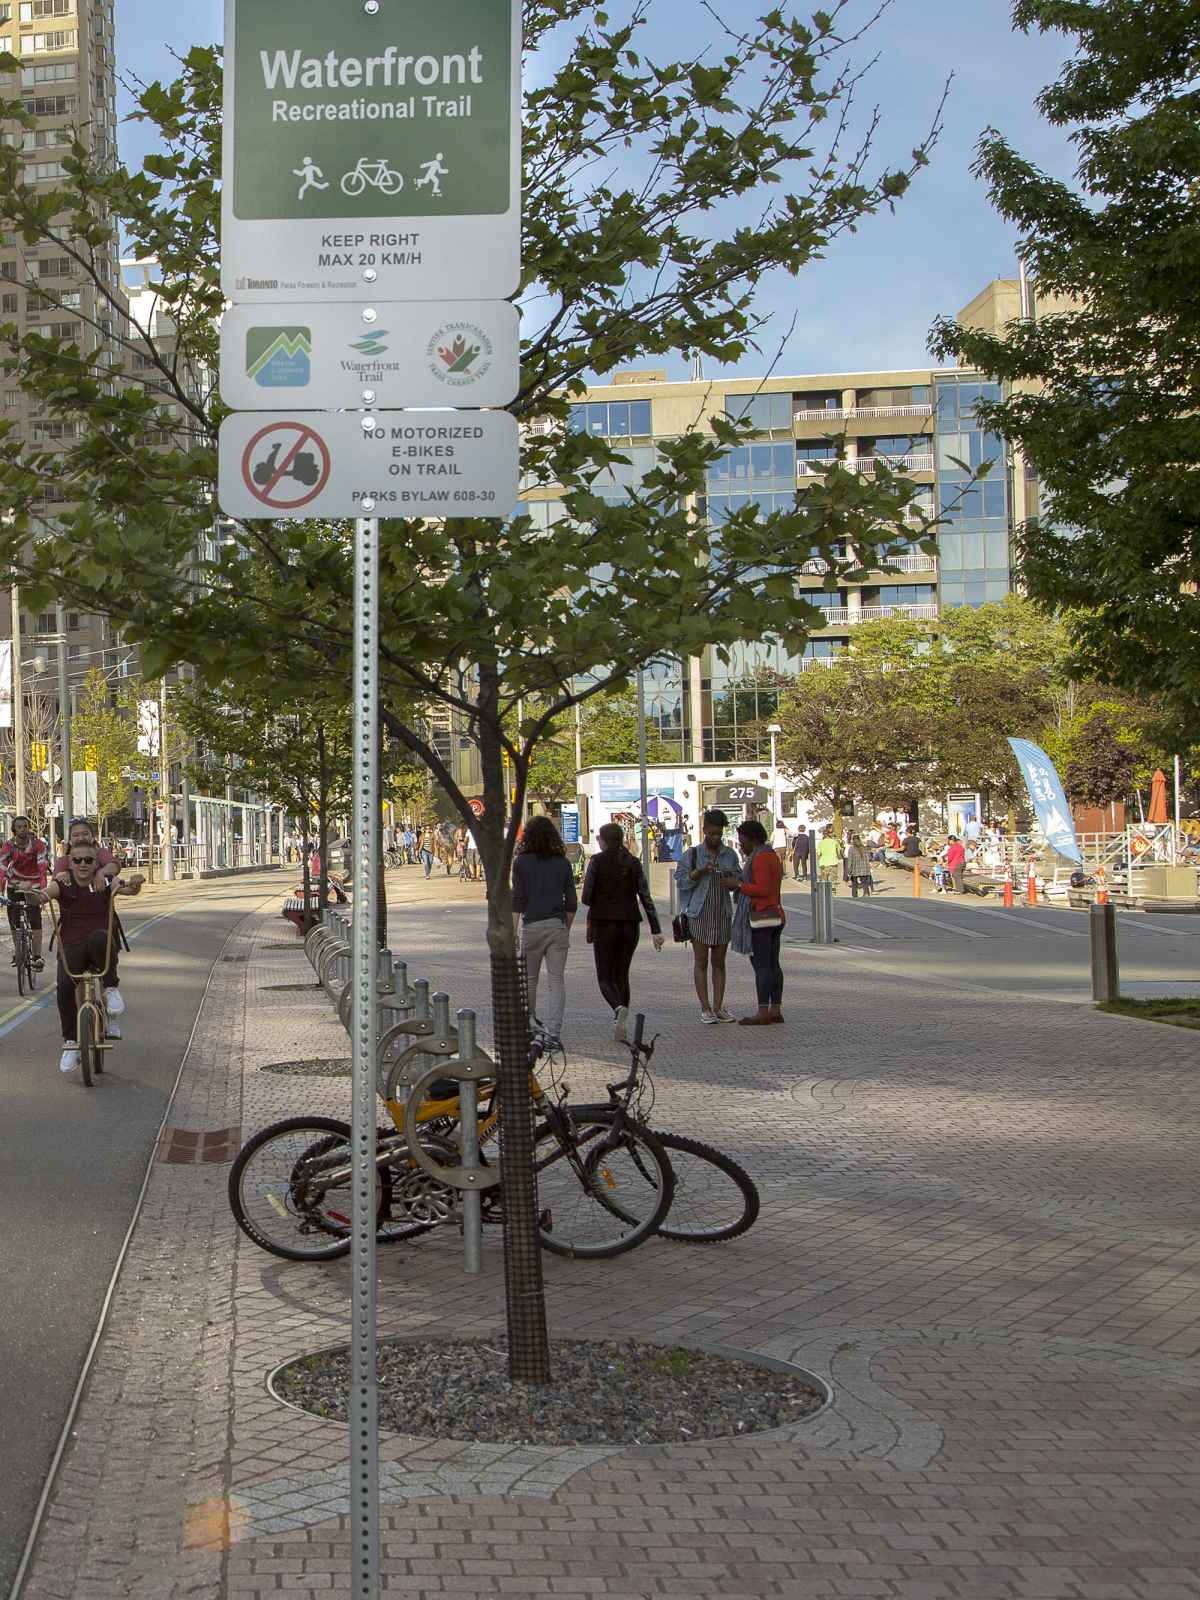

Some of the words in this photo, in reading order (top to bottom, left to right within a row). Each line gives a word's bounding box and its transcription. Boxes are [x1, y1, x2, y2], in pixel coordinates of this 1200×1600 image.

[260, 46, 484, 89] Waterfront
[272, 97, 415, 122] Recreational
[422, 95, 472, 118] Trail
[321, 234, 365, 248] KEEP
[369, 233, 420, 247] RIGHT
[318, 253, 354, 267] MAX
[358, 253, 377, 266] 20
[381, 252, 422, 265] KM/H
[246, 278, 278, 290] TORONTO
[340, 359, 400, 371] Waterfront
[356, 371, 383, 382] Trail
[363, 427, 386, 440] NO
[391, 427, 484, 440] MOTORIZED
[392, 445, 454, 458] E-BIKES
[388, 463, 411, 476] ON
[416, 463, 462, 476] TRAIL
[352, 490, 398, 502] PARKS
[402, 490, 450, 502] BYLAW
[454, 490, 496, 501] 608-30
[729, 787, 755, 799] 275
